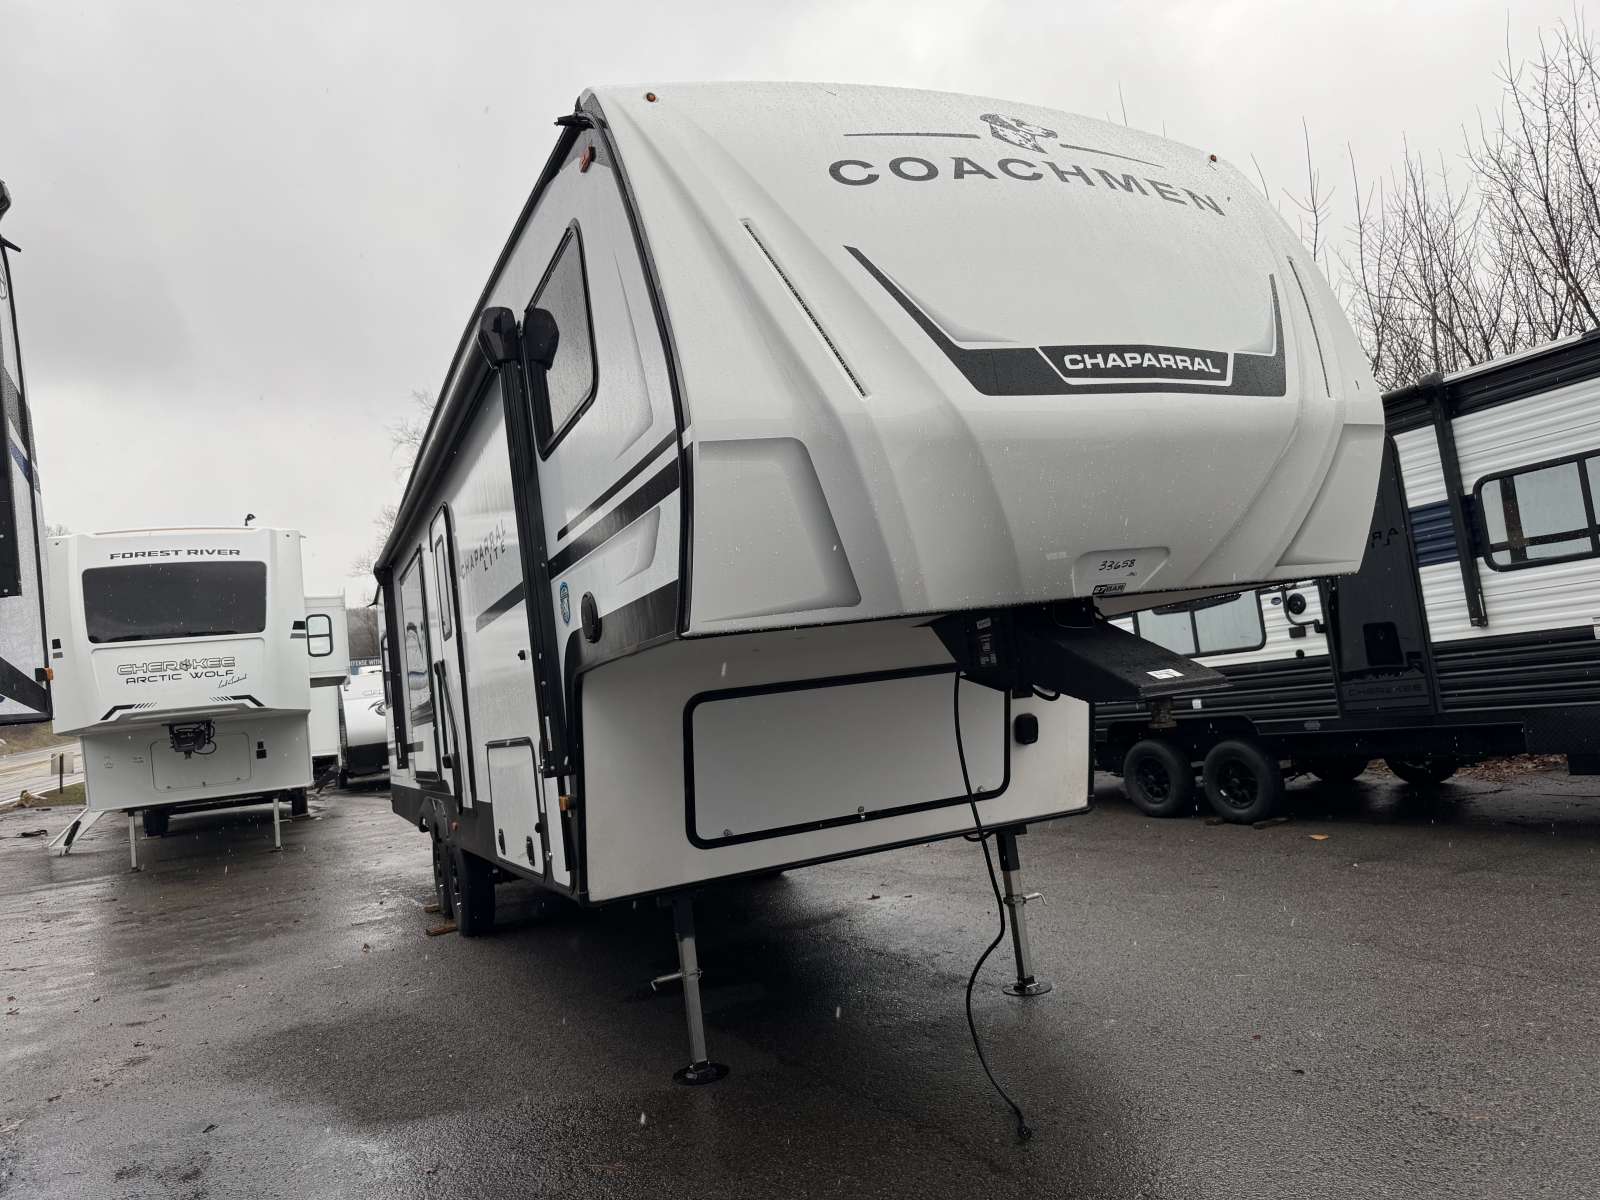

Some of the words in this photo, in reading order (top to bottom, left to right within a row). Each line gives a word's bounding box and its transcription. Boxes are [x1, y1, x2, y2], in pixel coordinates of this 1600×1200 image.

[829, 157, 1226, 217] COACHMEN
[1063, 352, 1221, 374] CHAPARRAL
[109, 549, 183, 560] FOREST
[186, 548, 241, 556] RIVER
[483, 540, 506, 572] LITE
[1098, 558, 1136, 571] 33658
[117, 656, 236, 675] CHEROKEE
[126, 673, 183, 685] ARCTIC
[189, 669, 235, 679] WOLF
